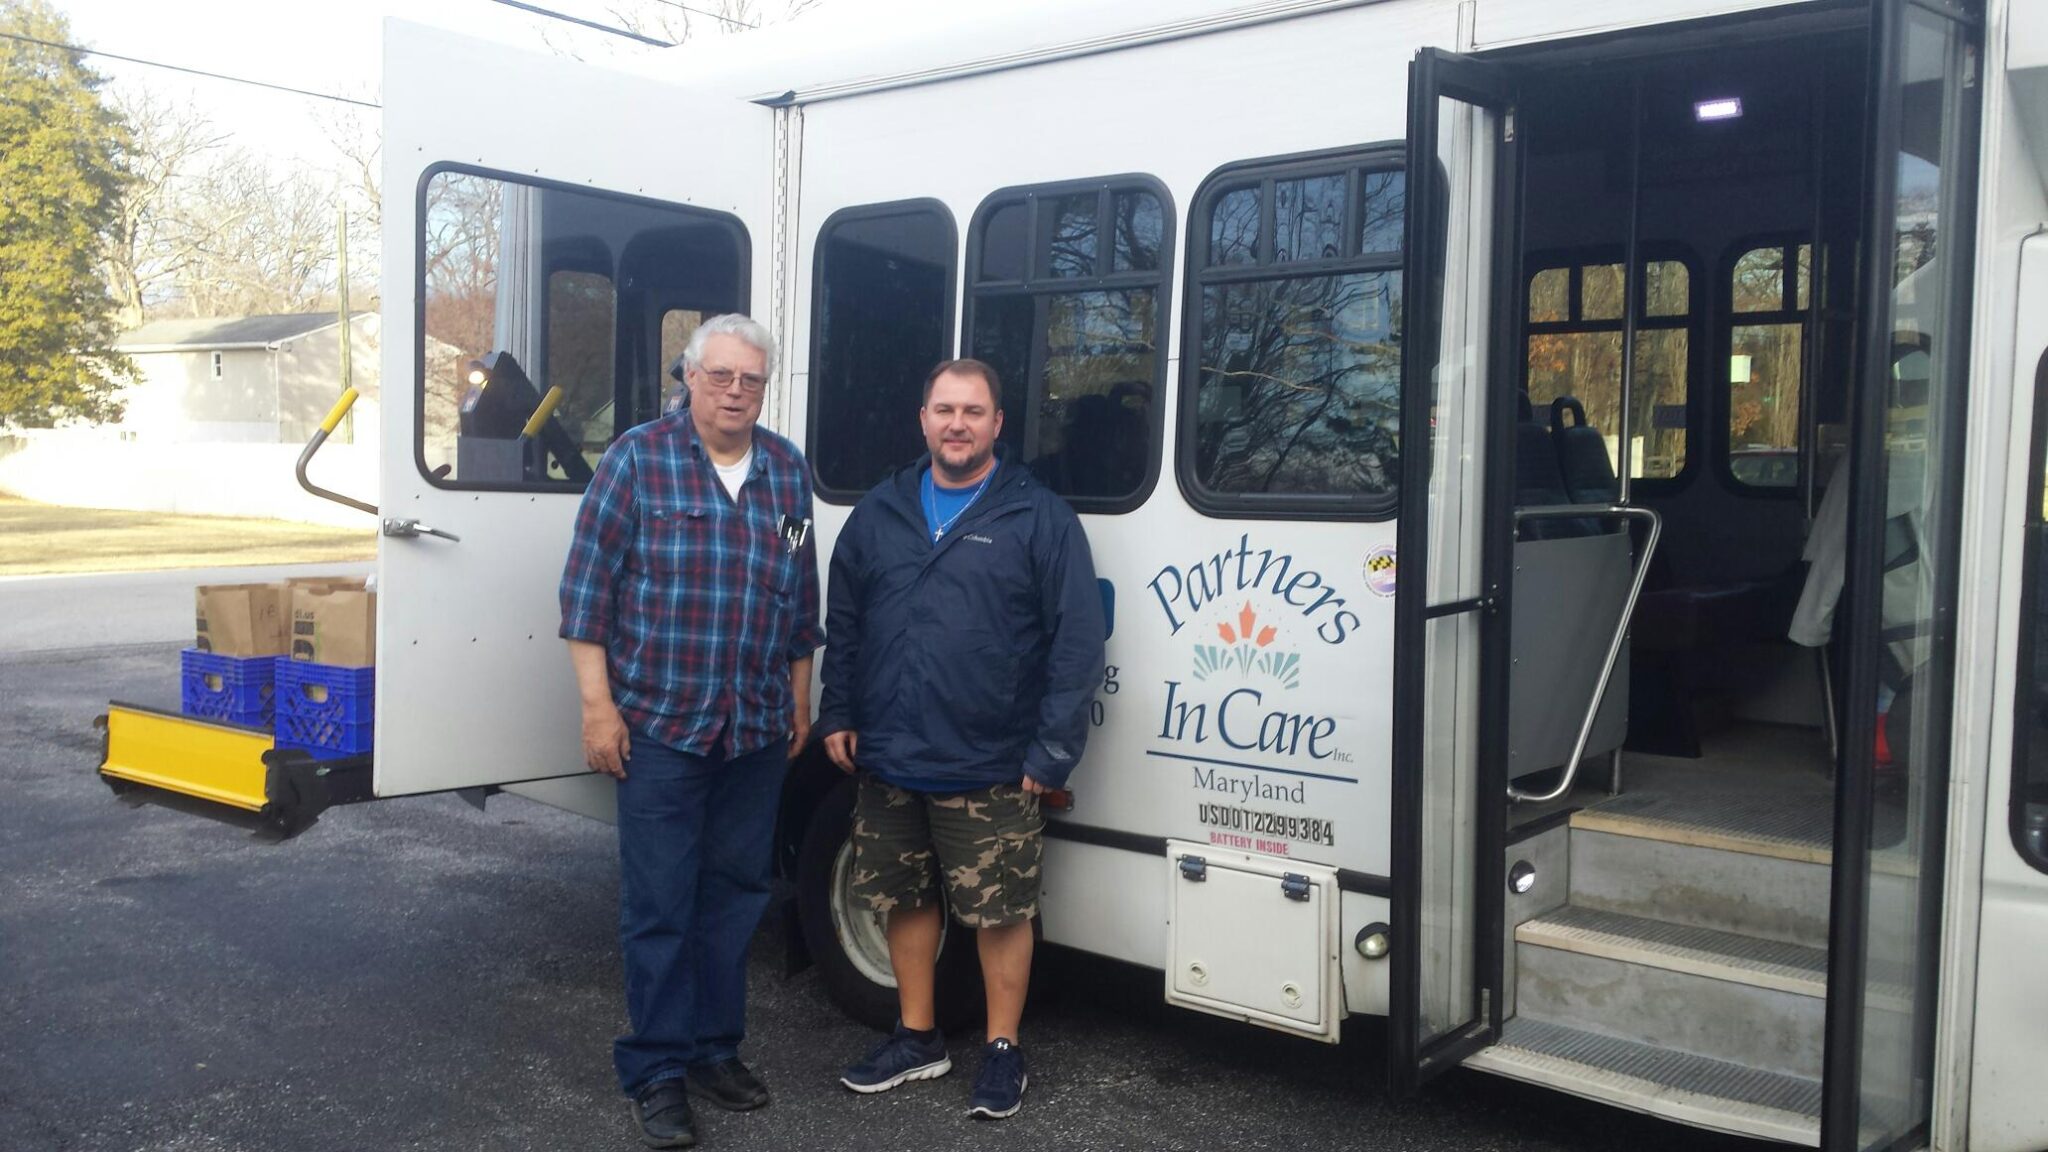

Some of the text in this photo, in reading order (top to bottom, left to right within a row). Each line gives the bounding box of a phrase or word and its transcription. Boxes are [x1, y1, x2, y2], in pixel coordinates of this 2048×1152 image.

[1147, 533, 1360, 645] Partners
[1157, 680, 1336, 759] In Care
[1333, 748, 1354, 763] Inc.
[1193, 766, 1305, 803] Maryland
[1209, 832, 1289, 855] BATTERY INSIDE
